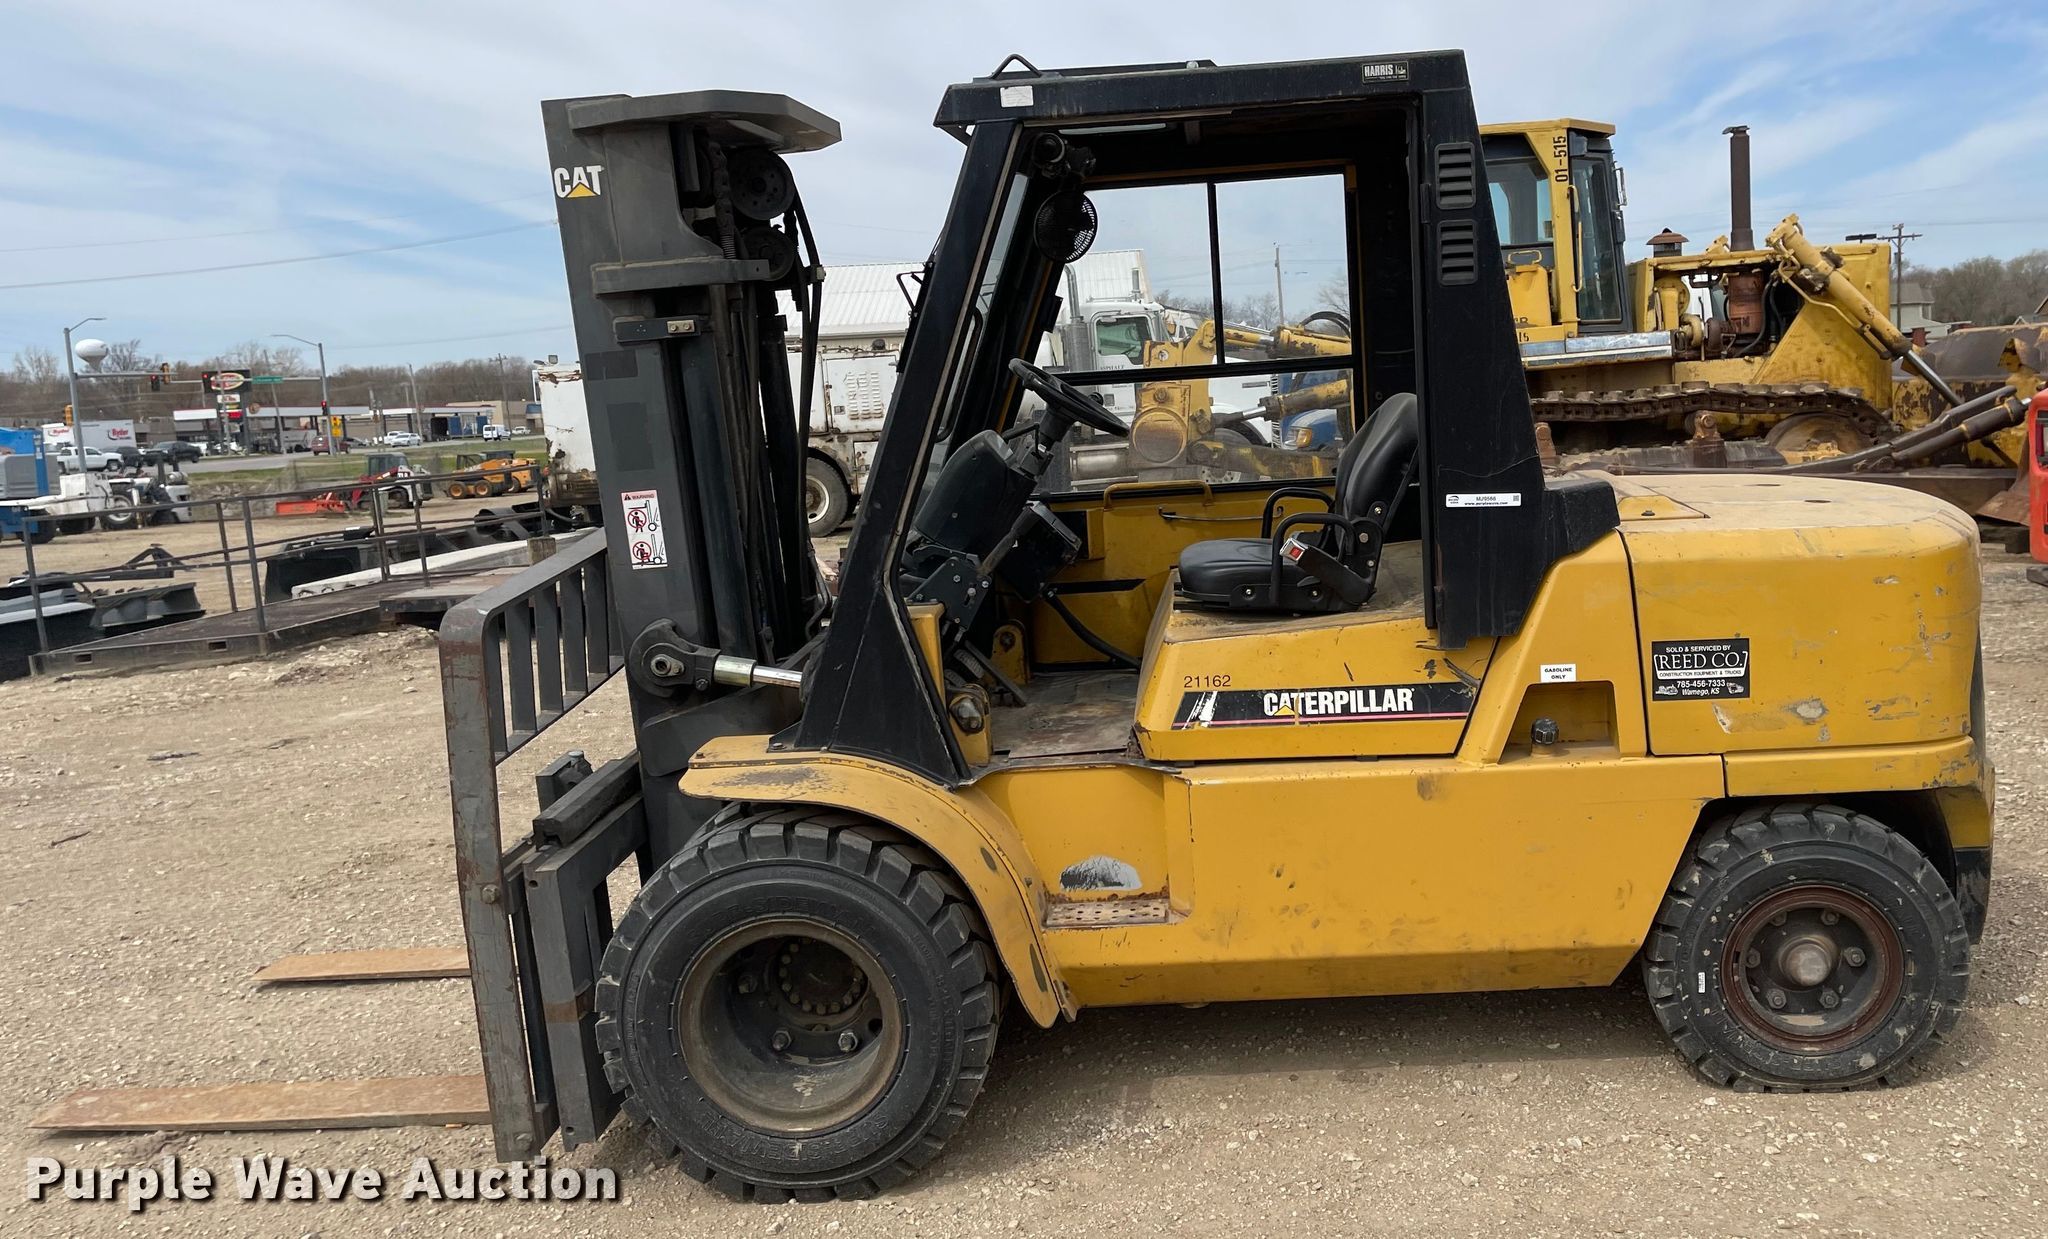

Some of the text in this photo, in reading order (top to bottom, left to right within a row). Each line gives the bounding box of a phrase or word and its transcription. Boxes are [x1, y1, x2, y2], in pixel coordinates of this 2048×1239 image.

[1364, 64, 1394, 77] HARRIS
[1553, 135, 1568, 182] 01-515
[554, 165, 602, 198] CAT
[1658, 652, 1743, 670] REED CO.
[1184, 674, 1232, 688] 21162
[1677, 679, 1726, 688] 785-456-7333
[1682, 688, 1710, 696] Wamego,
[1263, 688, 1415, 716] CATERPILLAR
